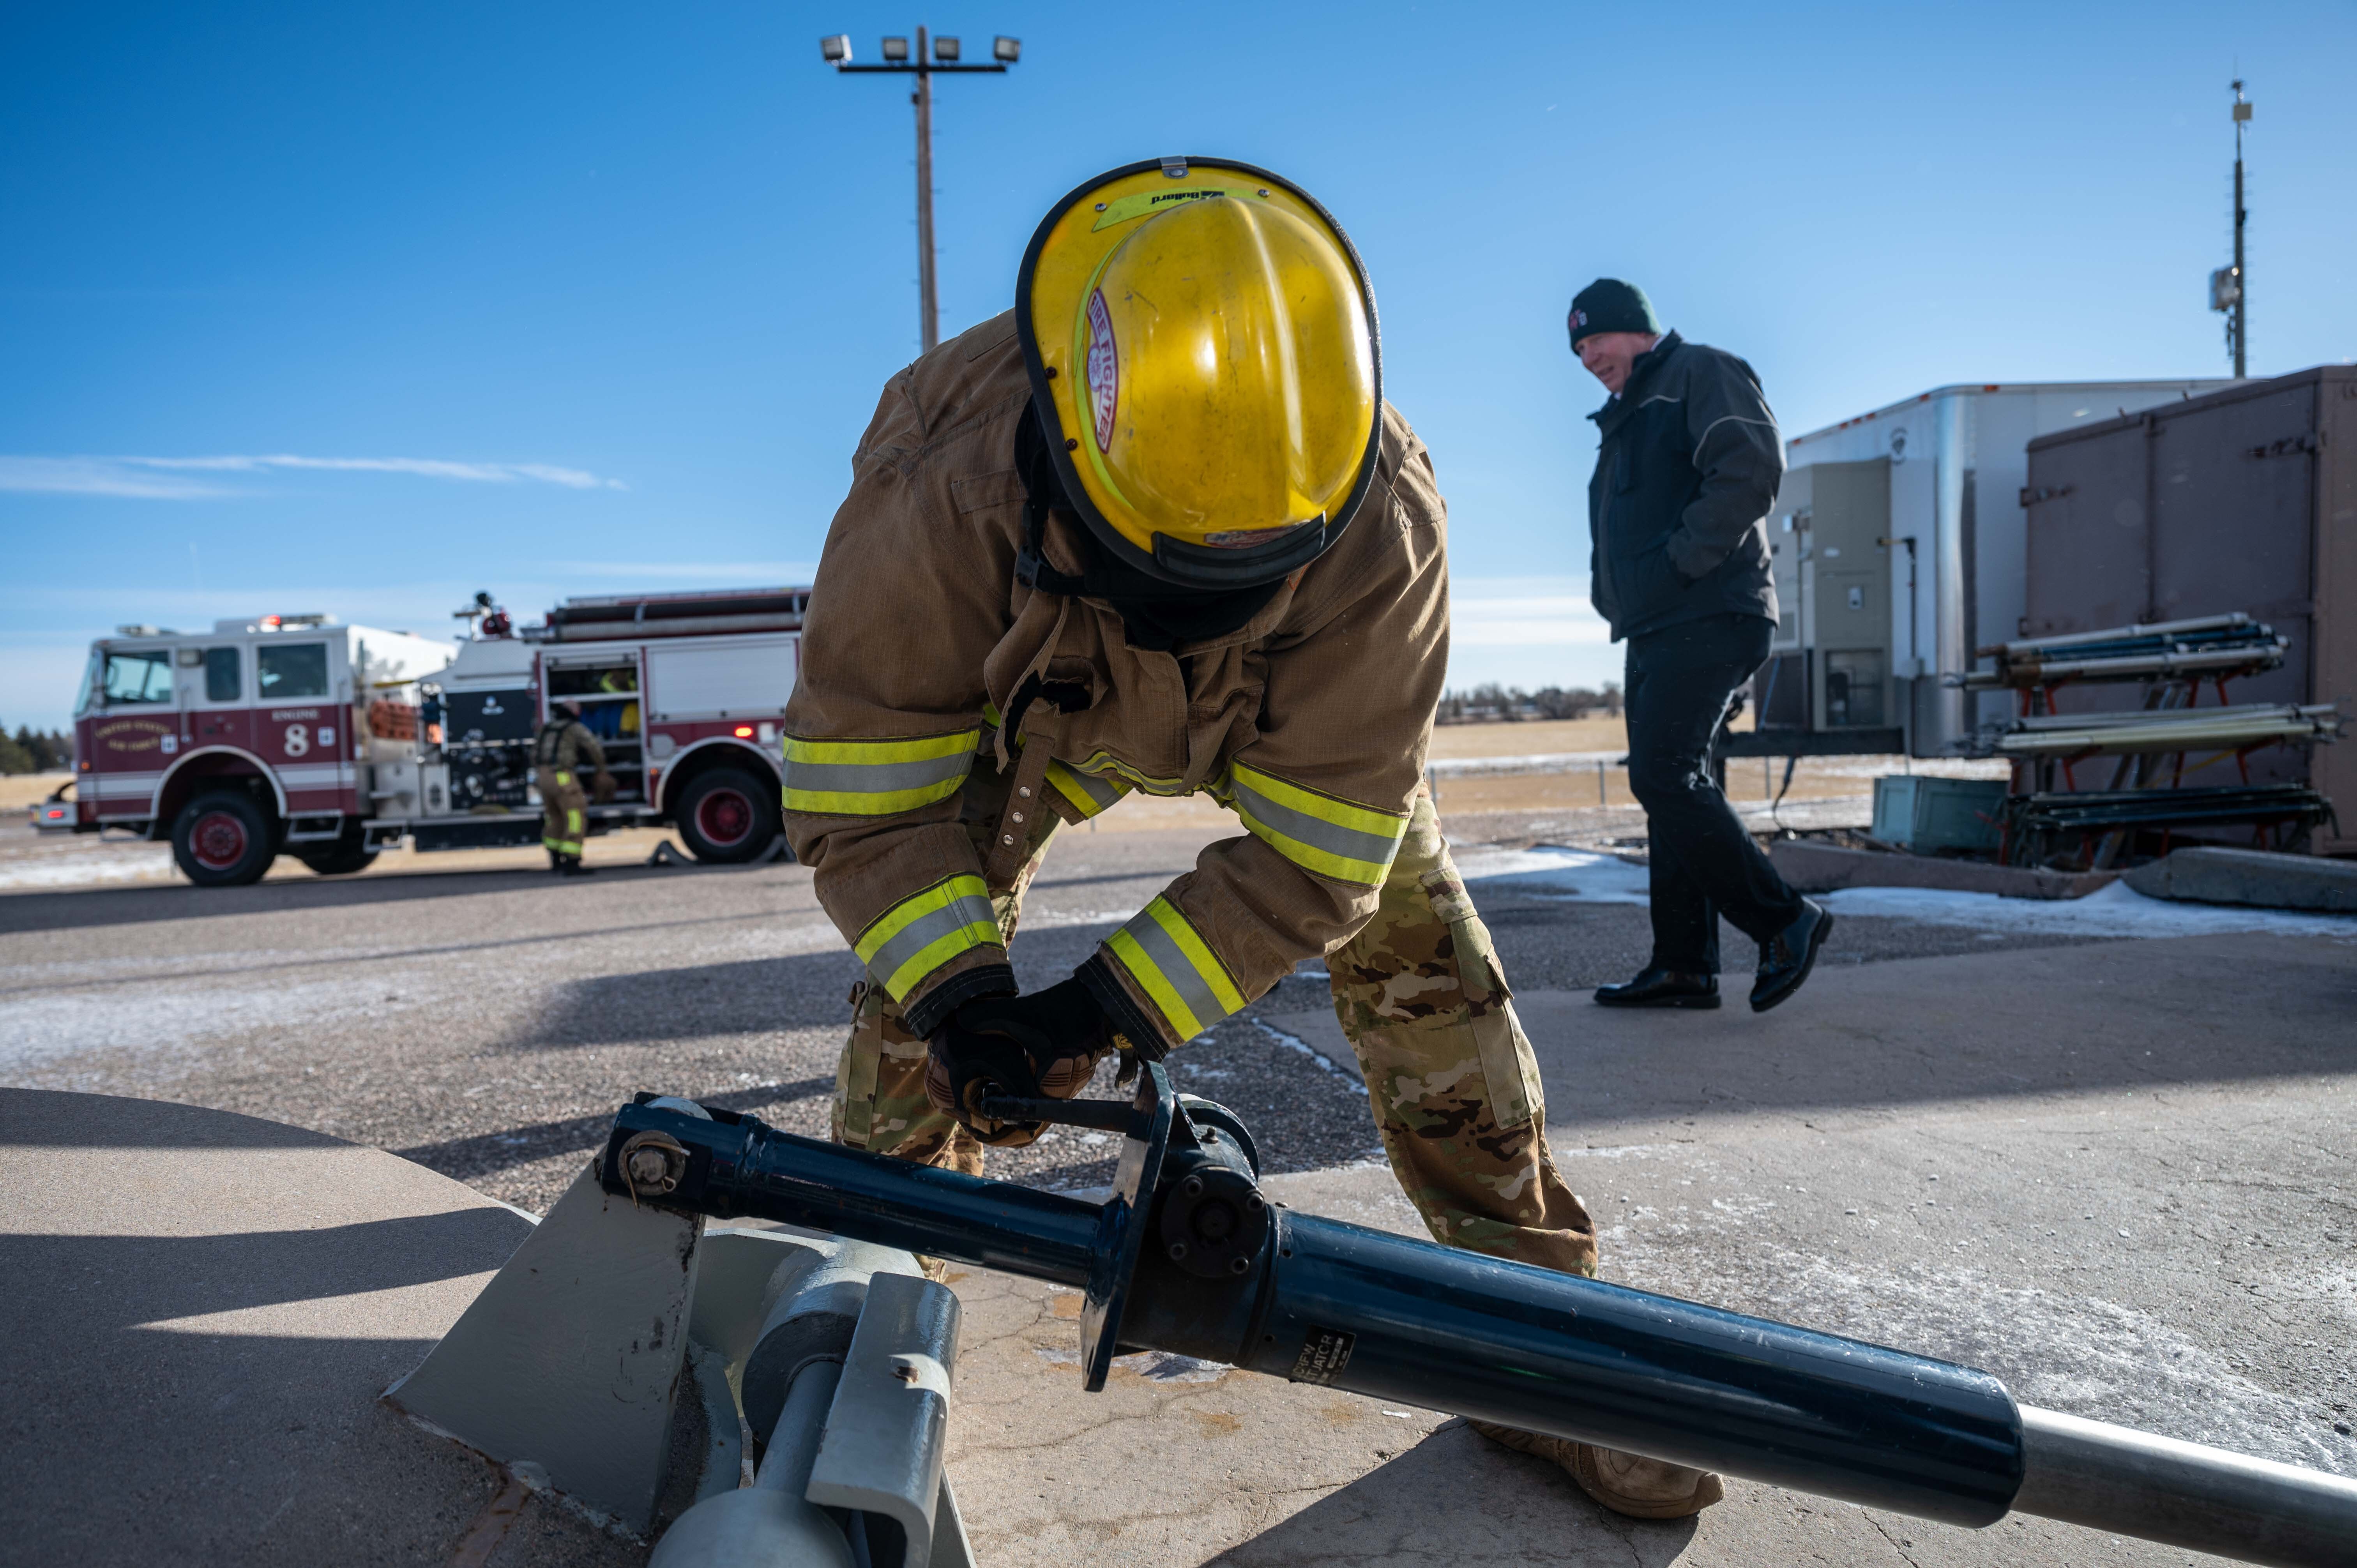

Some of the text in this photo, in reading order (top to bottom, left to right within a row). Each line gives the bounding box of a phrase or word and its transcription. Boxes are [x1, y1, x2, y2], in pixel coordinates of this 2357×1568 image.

[1150, 192, 1200, 204] Bullard
[1098, 339, 1113, 444] FIGHTER
[283, 723, 310, 757] 8
